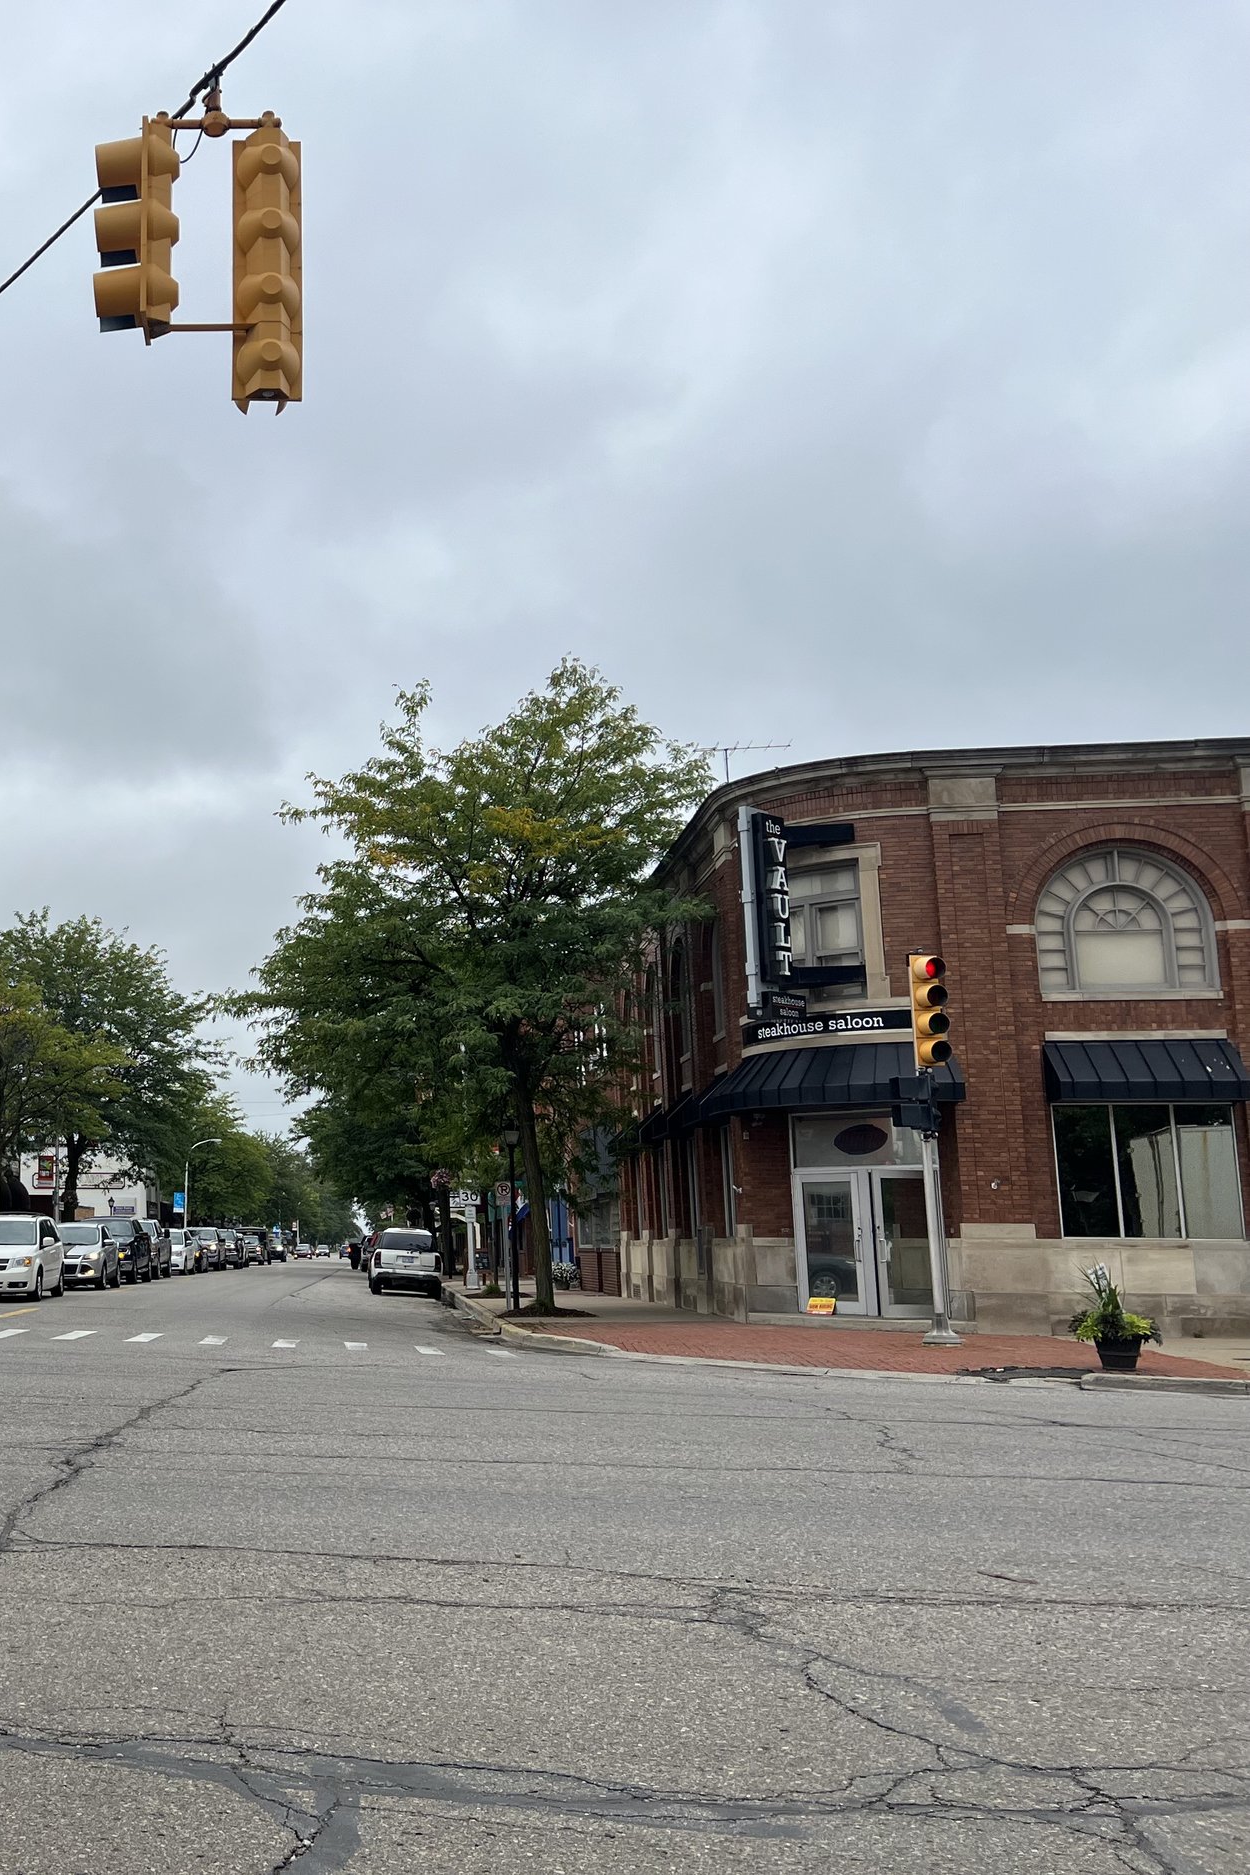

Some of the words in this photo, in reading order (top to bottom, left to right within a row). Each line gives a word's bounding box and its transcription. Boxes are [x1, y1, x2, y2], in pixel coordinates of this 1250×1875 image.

[765, 819, 782, 835] the
[765, 837, 793, 976] VAULT
[772, 994, 806, 1007] steakhouse
[779, 1007, 800, 1018] saloon
[757, 1019, 824, 1039] steakhouse
[828, 1015, 884, 1031] saloon
[461, 1191, 479, 1202] 30
